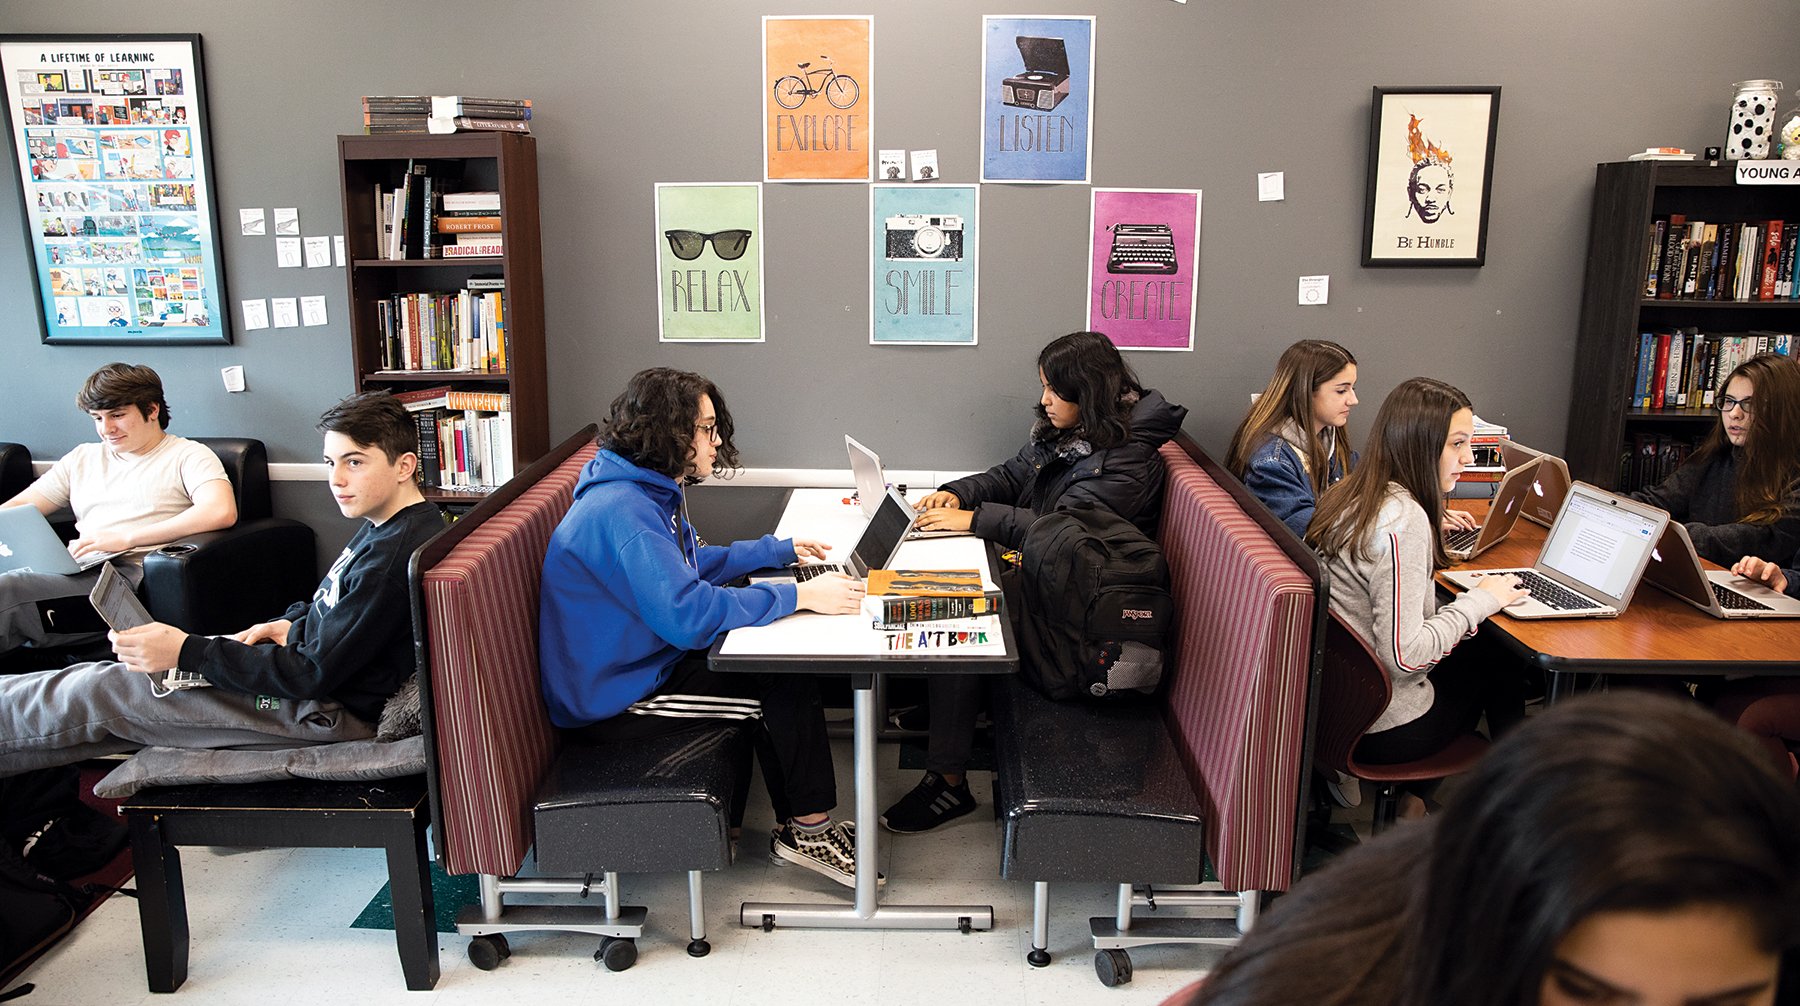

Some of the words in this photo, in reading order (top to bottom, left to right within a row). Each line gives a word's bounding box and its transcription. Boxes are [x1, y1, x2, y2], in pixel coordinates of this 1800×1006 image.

[40, 54, 46, 62] A
[51, 53, 90, 62] LIFETIME
[95, 53, 105, 62] OF
[110, 53, 154, 63] LEARNING
[777, 114, 859, 151] EXPLORE
[1000, 115, 1074, 152] LISTEN
[1739, 168, 1789, 178] YOUNG
[448, 246, 478, 255] RADICAL
[1667, 234, 1676, 257] BLOOD
[1721, 228, 1731, 265] SLAMMED
[672, 270, 751, 312] RELAX
[885, 270, 962, 315] SMILE
[1101, 280, 1184, 320] CREATE
[448, 392, 502, 411] VONNEGUT
[886, 633, 913, 650] THE
[948, 632, 988, 647] BOOK
